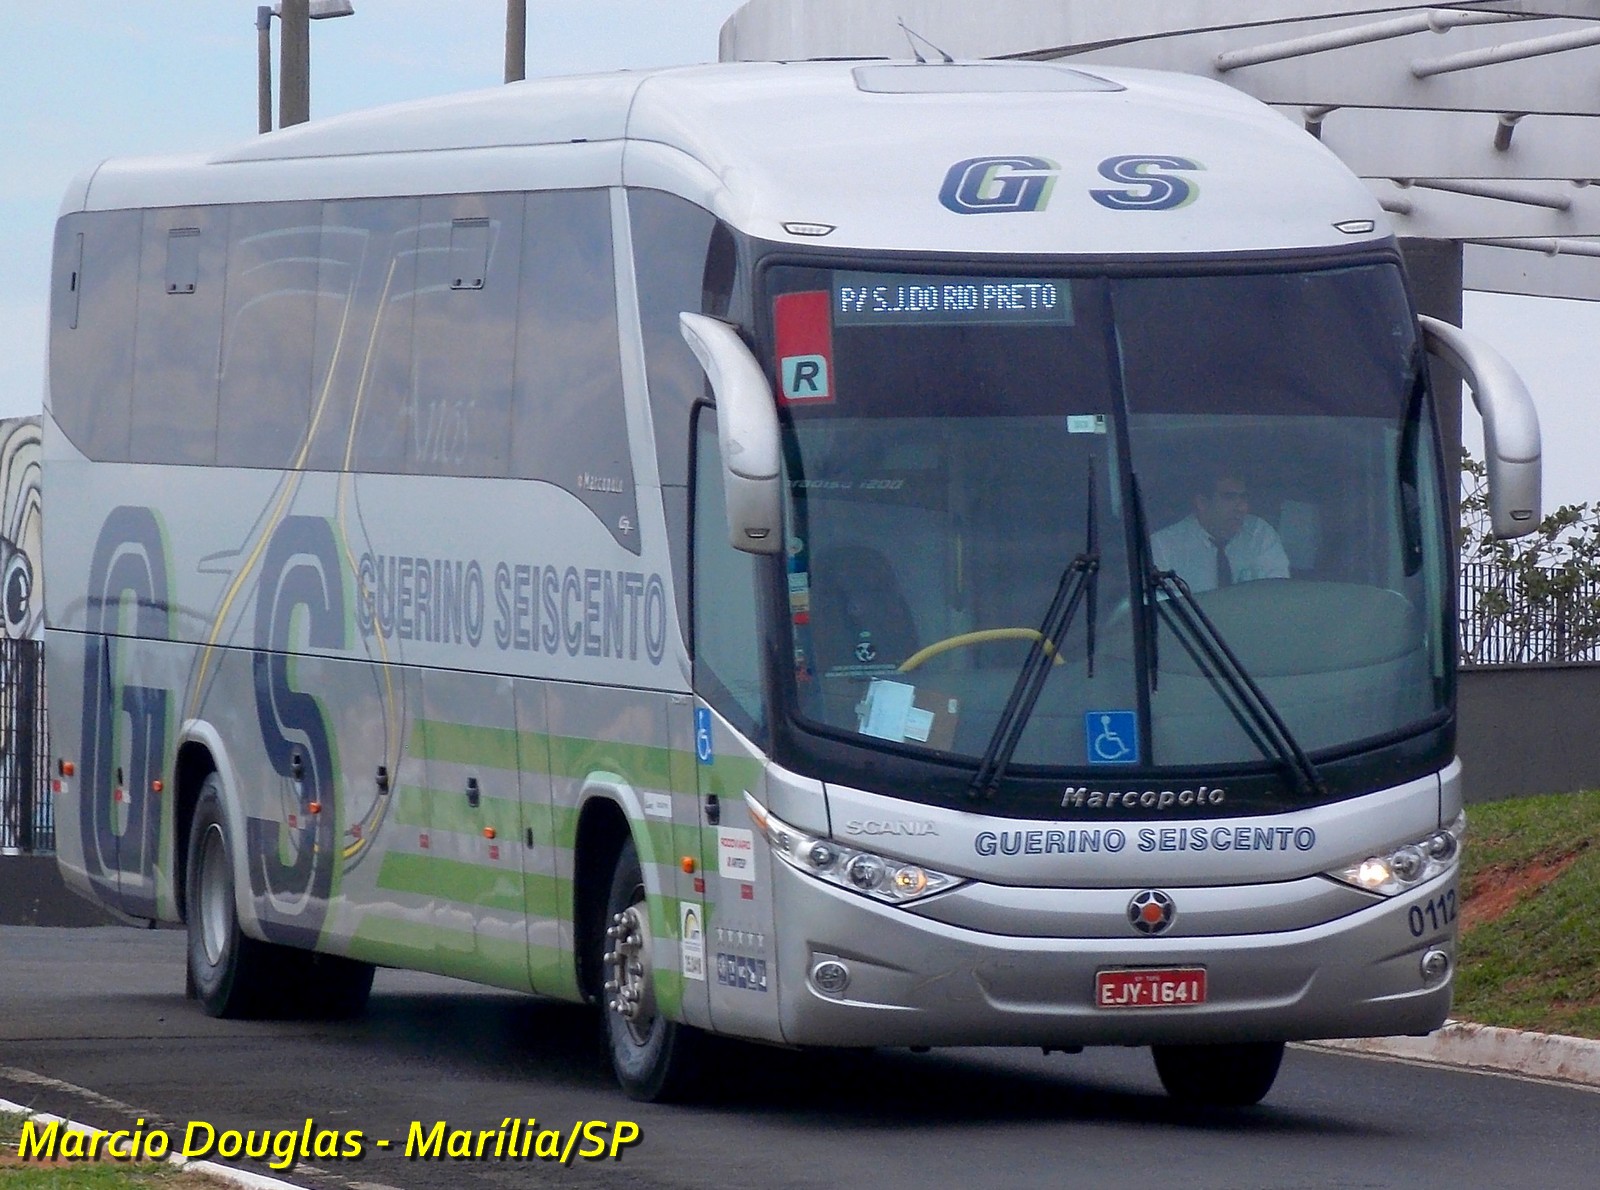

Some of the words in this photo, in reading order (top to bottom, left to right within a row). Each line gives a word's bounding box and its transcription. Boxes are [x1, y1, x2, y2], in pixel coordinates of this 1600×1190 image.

[943, 285, 979, 310] RIO
[983, 283, 1057, 309] PRETO
[793, 361, 820, 392] R
[356, 551, 485, 649] GUERINO
[493, 561, 667, 665] SEISCENTO
[1060, 786, 1226, 810] Marcopolo
[846, 820, 939, 836] SCANIA
[974, 829, 1126, 857] GUERINO
[1137, 826, 1317, 853] SEISCENTO
